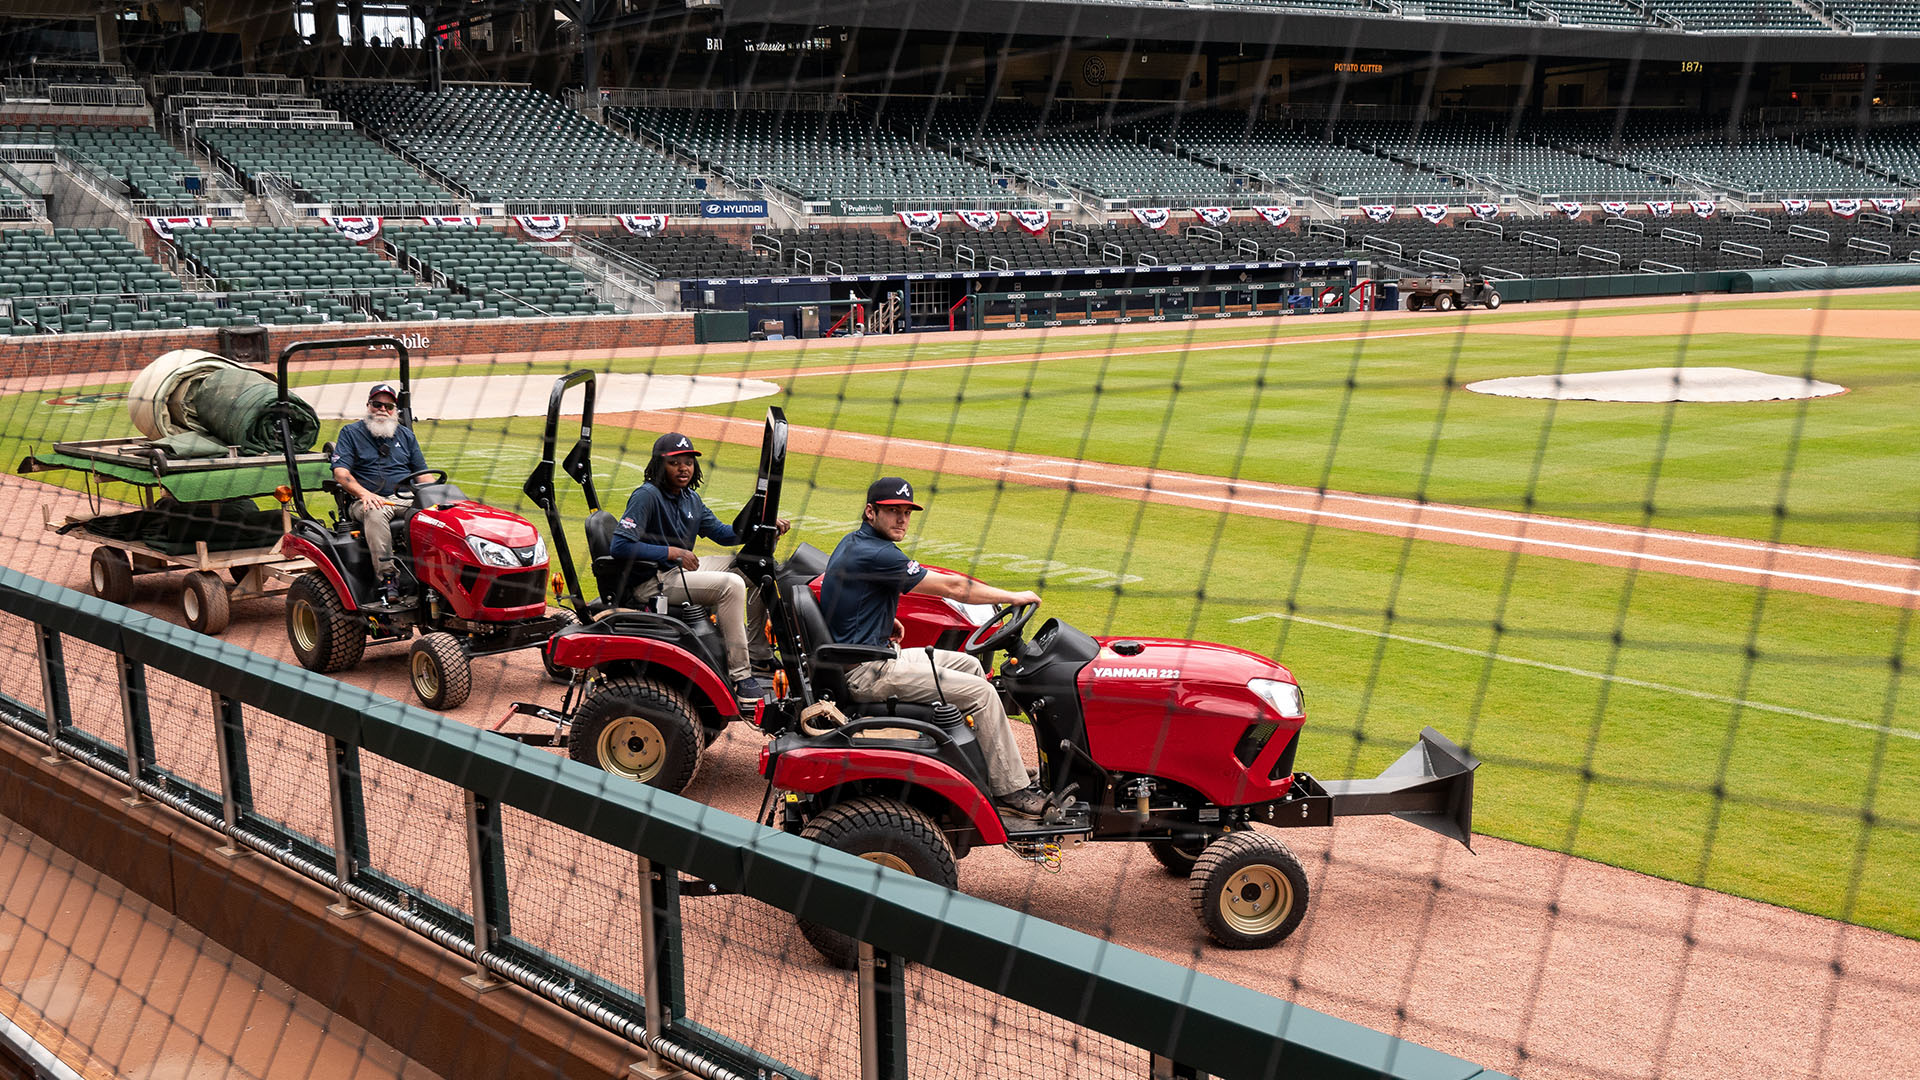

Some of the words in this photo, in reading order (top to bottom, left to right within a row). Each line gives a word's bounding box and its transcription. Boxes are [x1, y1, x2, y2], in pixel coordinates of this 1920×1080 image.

[1334, 63, 1359, 72] POTATO
[1360, 64, 1383, 73] CUTTER
[723, 205, 763, 213] HYUNDAI
[848, 203, 884, 212] PruittHealth
[676, 437, 689, 448] A
[895, 483, 910, 497] A
[1093, 667, 1158, 678] YANMAR
[1159, 669, 1180, 679] 223
